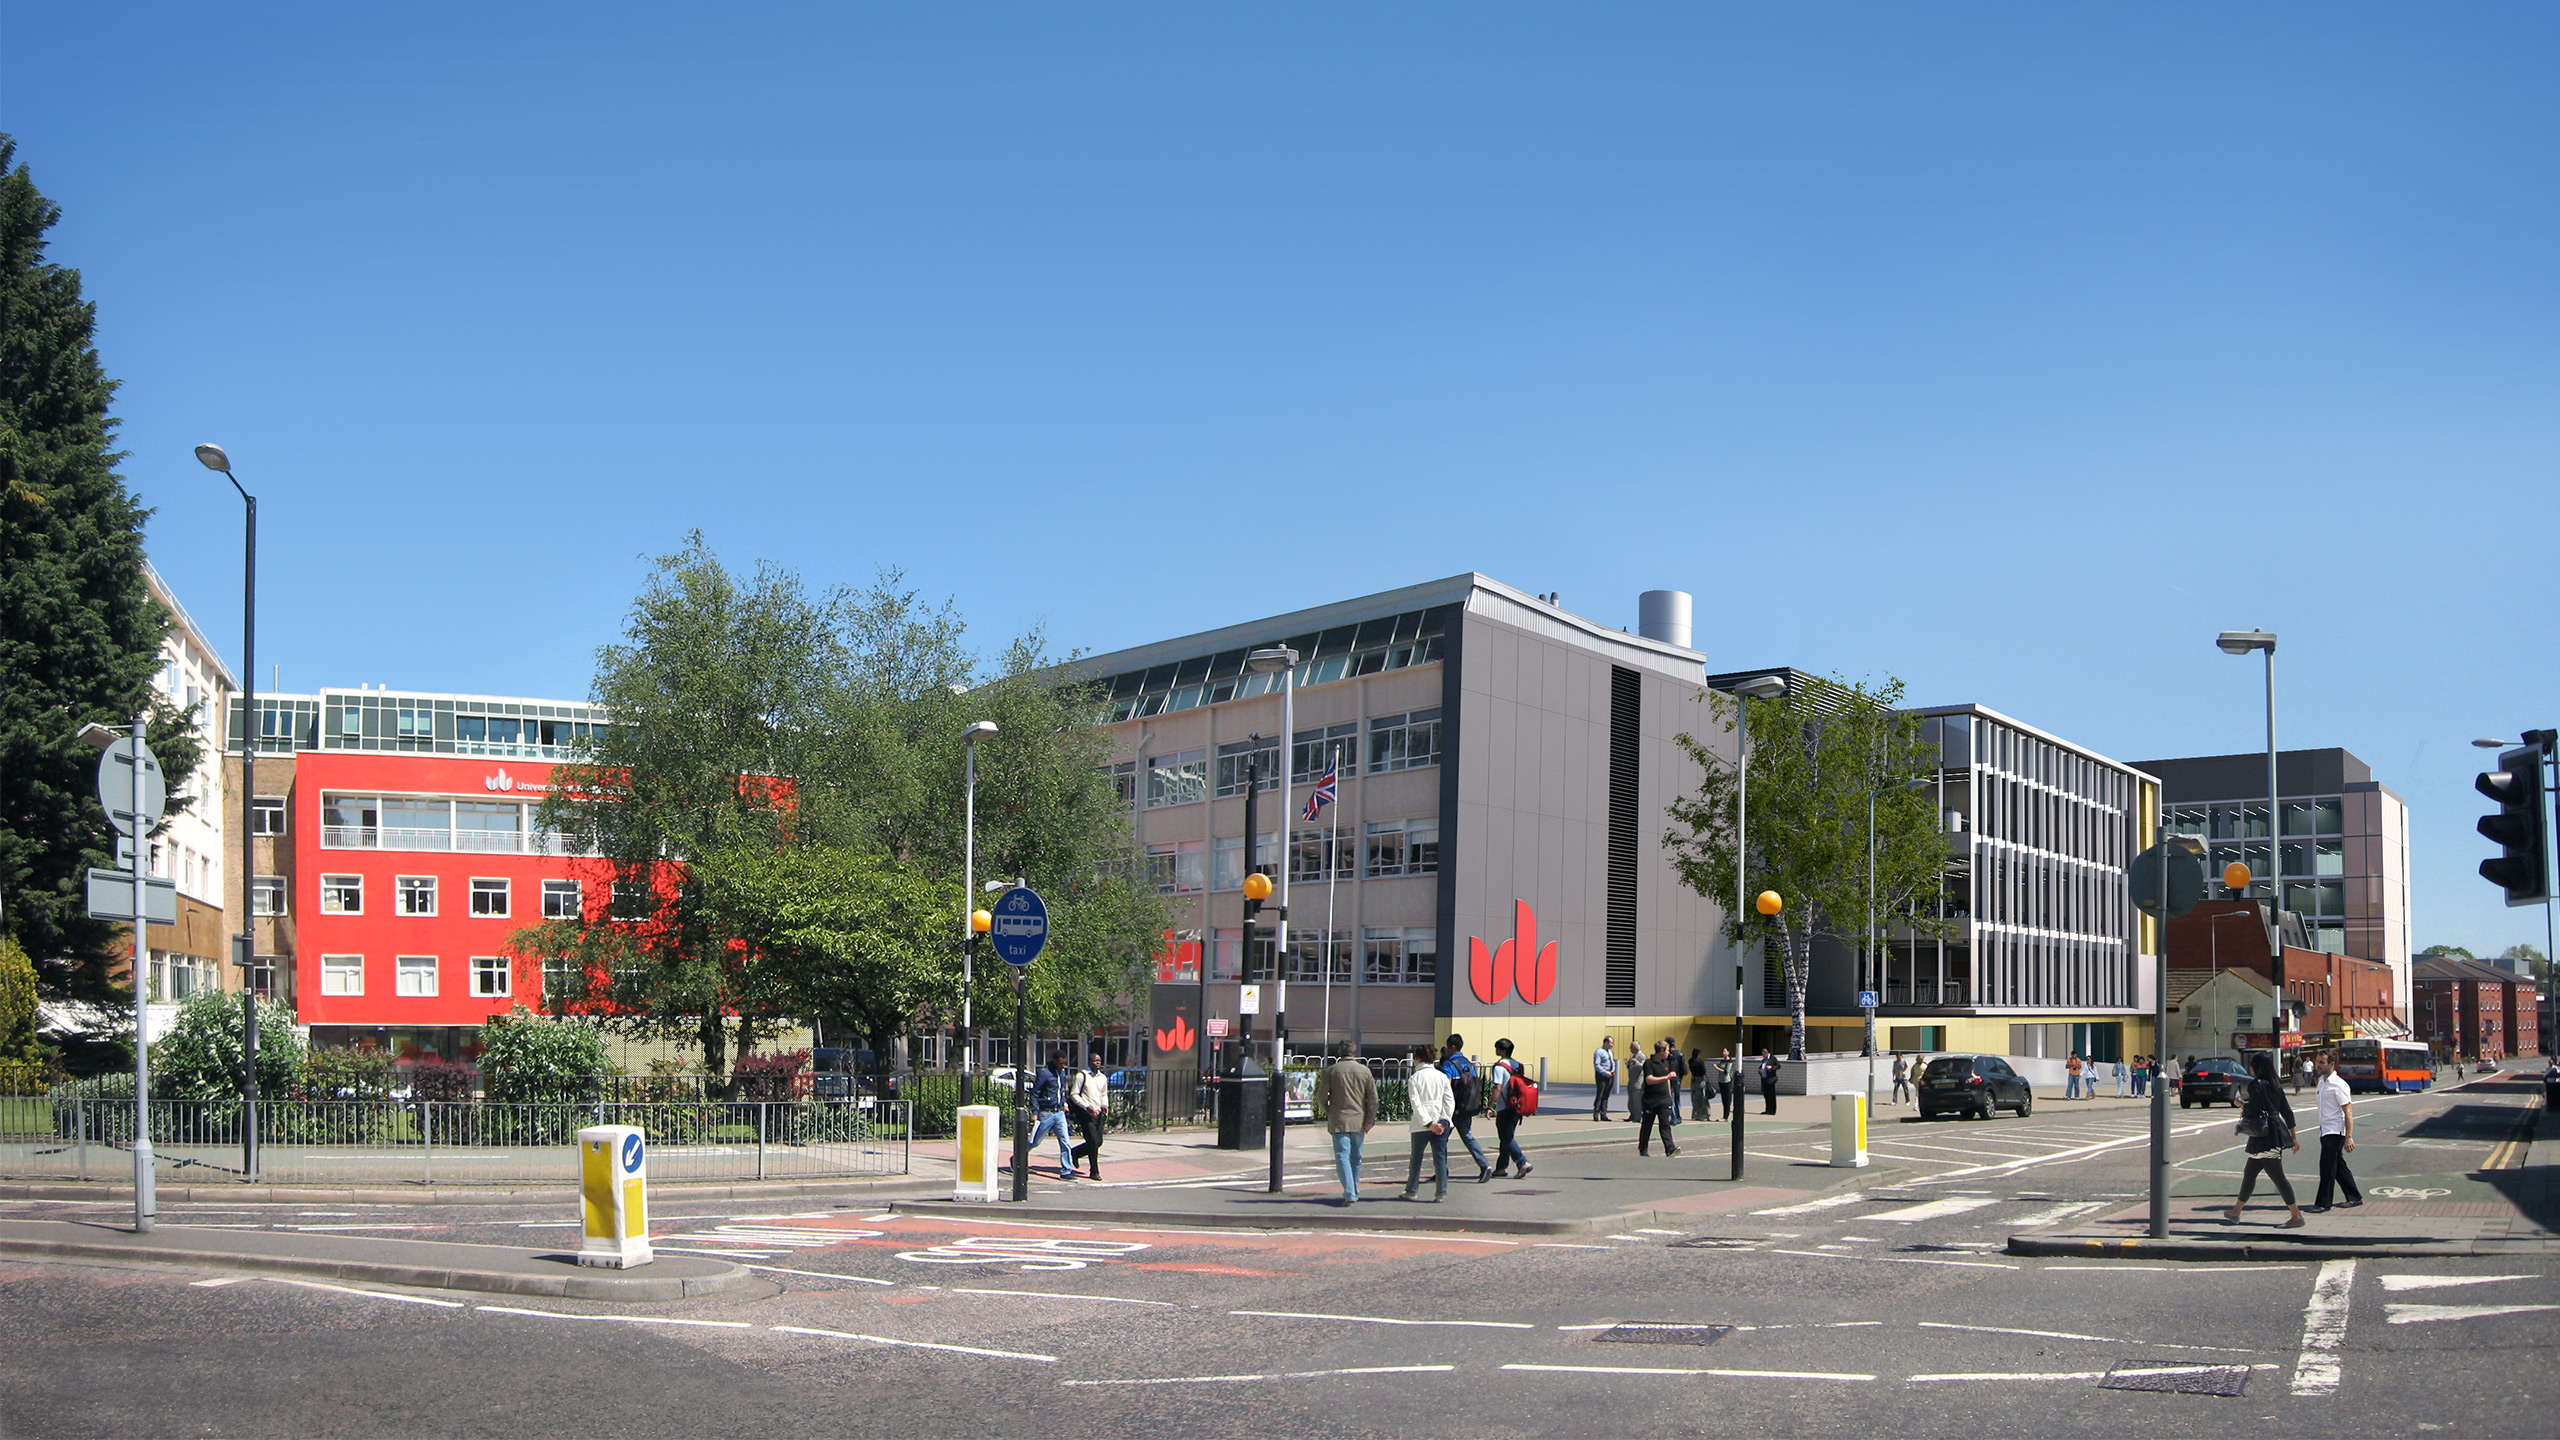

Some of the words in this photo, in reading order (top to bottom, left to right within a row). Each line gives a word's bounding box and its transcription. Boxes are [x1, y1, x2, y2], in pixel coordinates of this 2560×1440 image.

[1009, 945, 1026, 955] taxi
[593, 1142, 599, 1150] 4
[894, 1237, 1153, 1271] BUS
